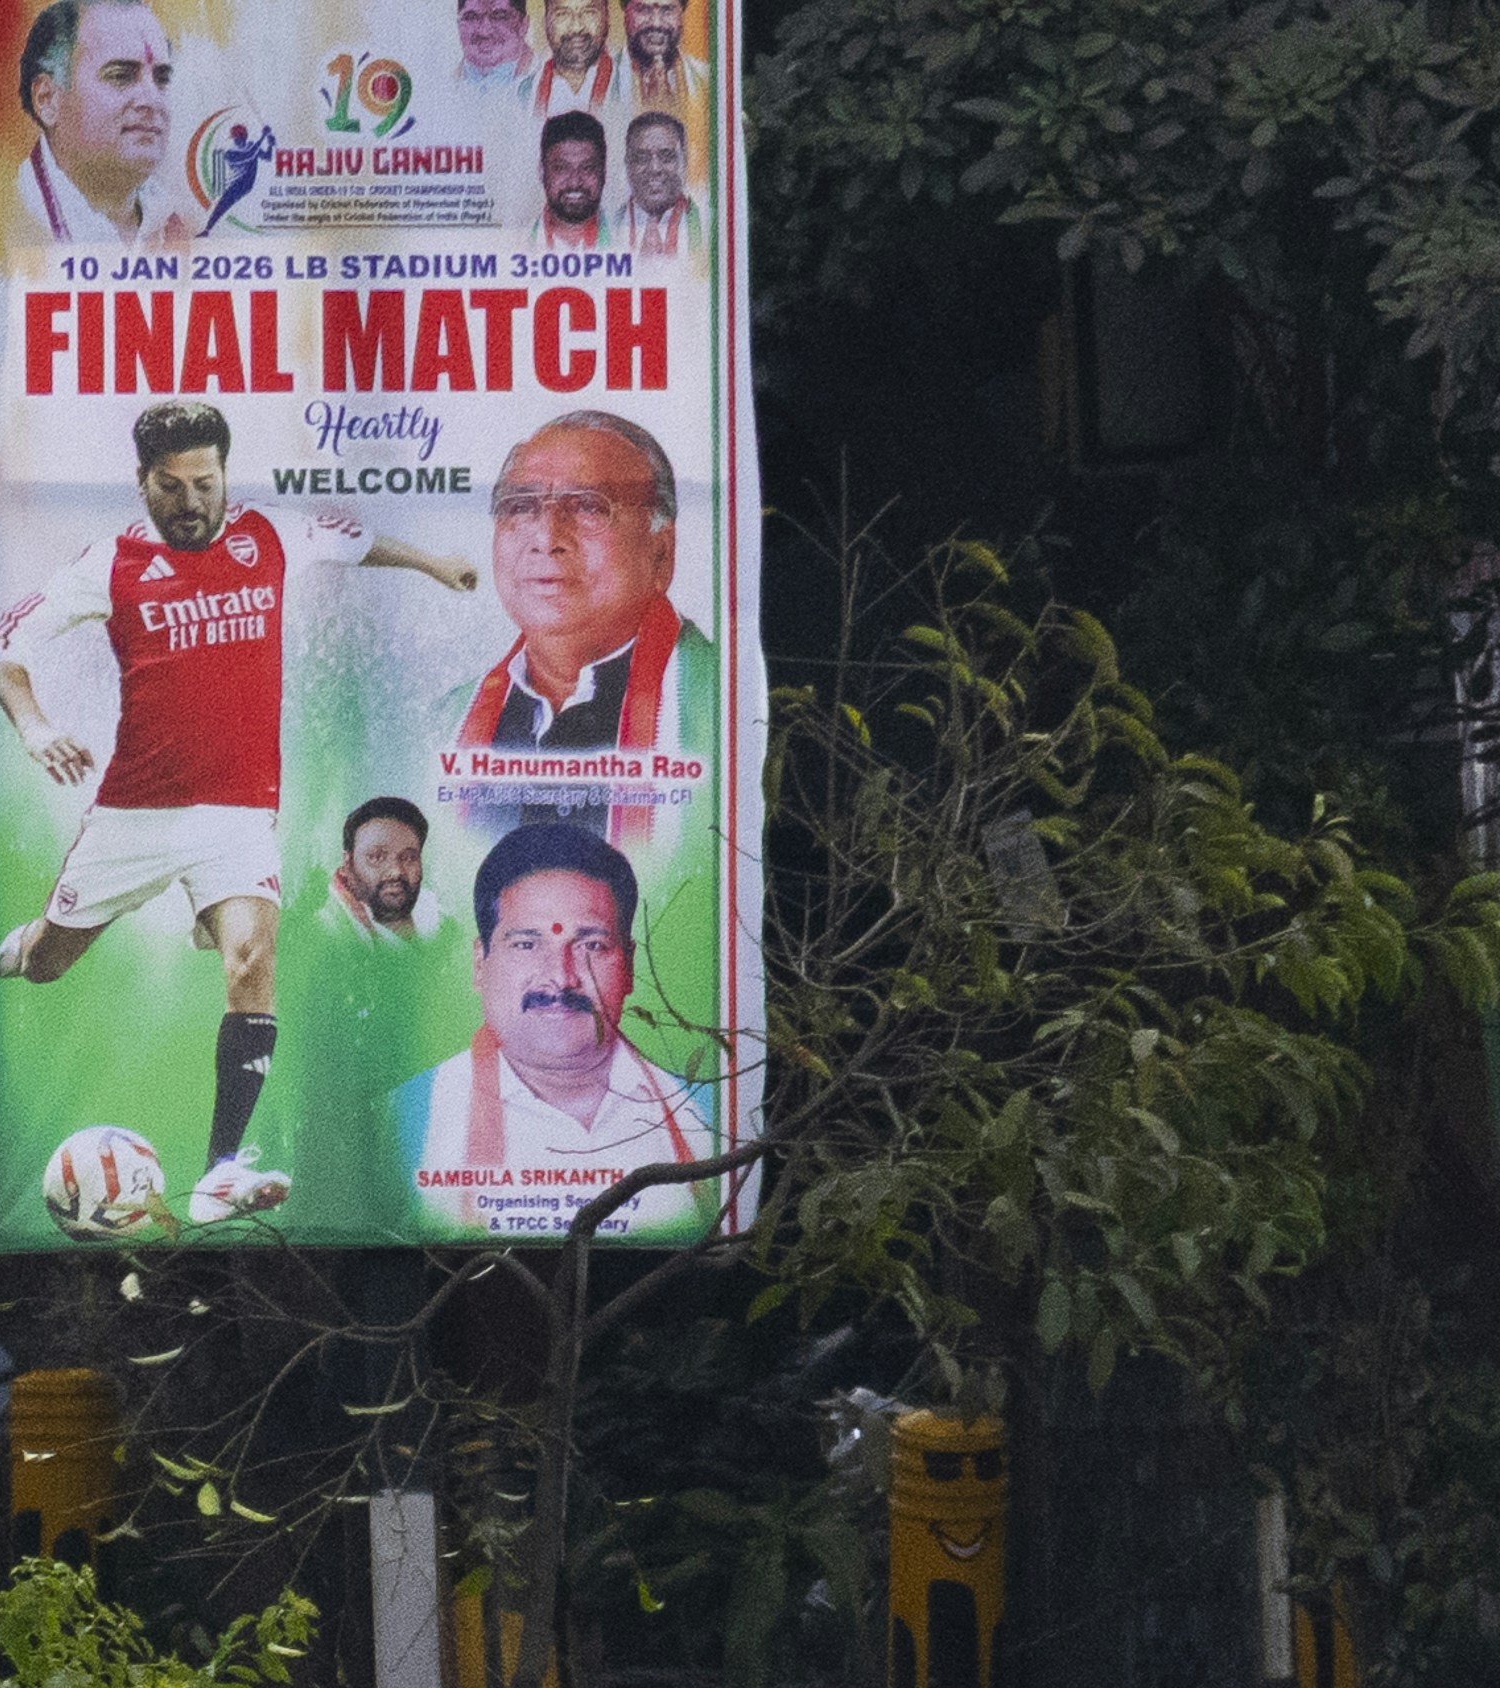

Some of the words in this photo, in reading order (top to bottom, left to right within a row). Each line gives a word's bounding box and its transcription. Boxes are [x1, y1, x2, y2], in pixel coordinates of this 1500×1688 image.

[324, 53, 413, 138] 19
[274, 146, 364, 177] RAJIV
[372, 145, 484, 176] GANDHI
[60, 256, 101, 281] 10
[111, 256, 179, 281] JAN
[191, 256, 274, 281] 2026
[286, 255, 329, 280] LB
[339, 254, 498, 280] STADIUM
[510, 253, 634, 279] 3:00PM
[24, 289, 295, 396] FINAL
[321, 287, 668, 393] MATCH
[304, 399, 445, 460] Heartly
[273, 466, 473, 497] WELCOME
[139, 585, 276, 632] Emirates
[169, 624, 199, 652] FLY
[206, 614, 266, 645] BETTER
[440, 753, 460, 775] V.
[471, 754, 642, 777] Hanumantha
[653, 755, 702, 779] Rao
[417, 1169, 514, 1188] SAMBULA
[520, 1168, 624, 1186] SRIKANTH
[477, 1195, 560, 1212] Organising
[489, 1217, 501, 1230] &
[506, 1217, 548, 1230] TPCC
